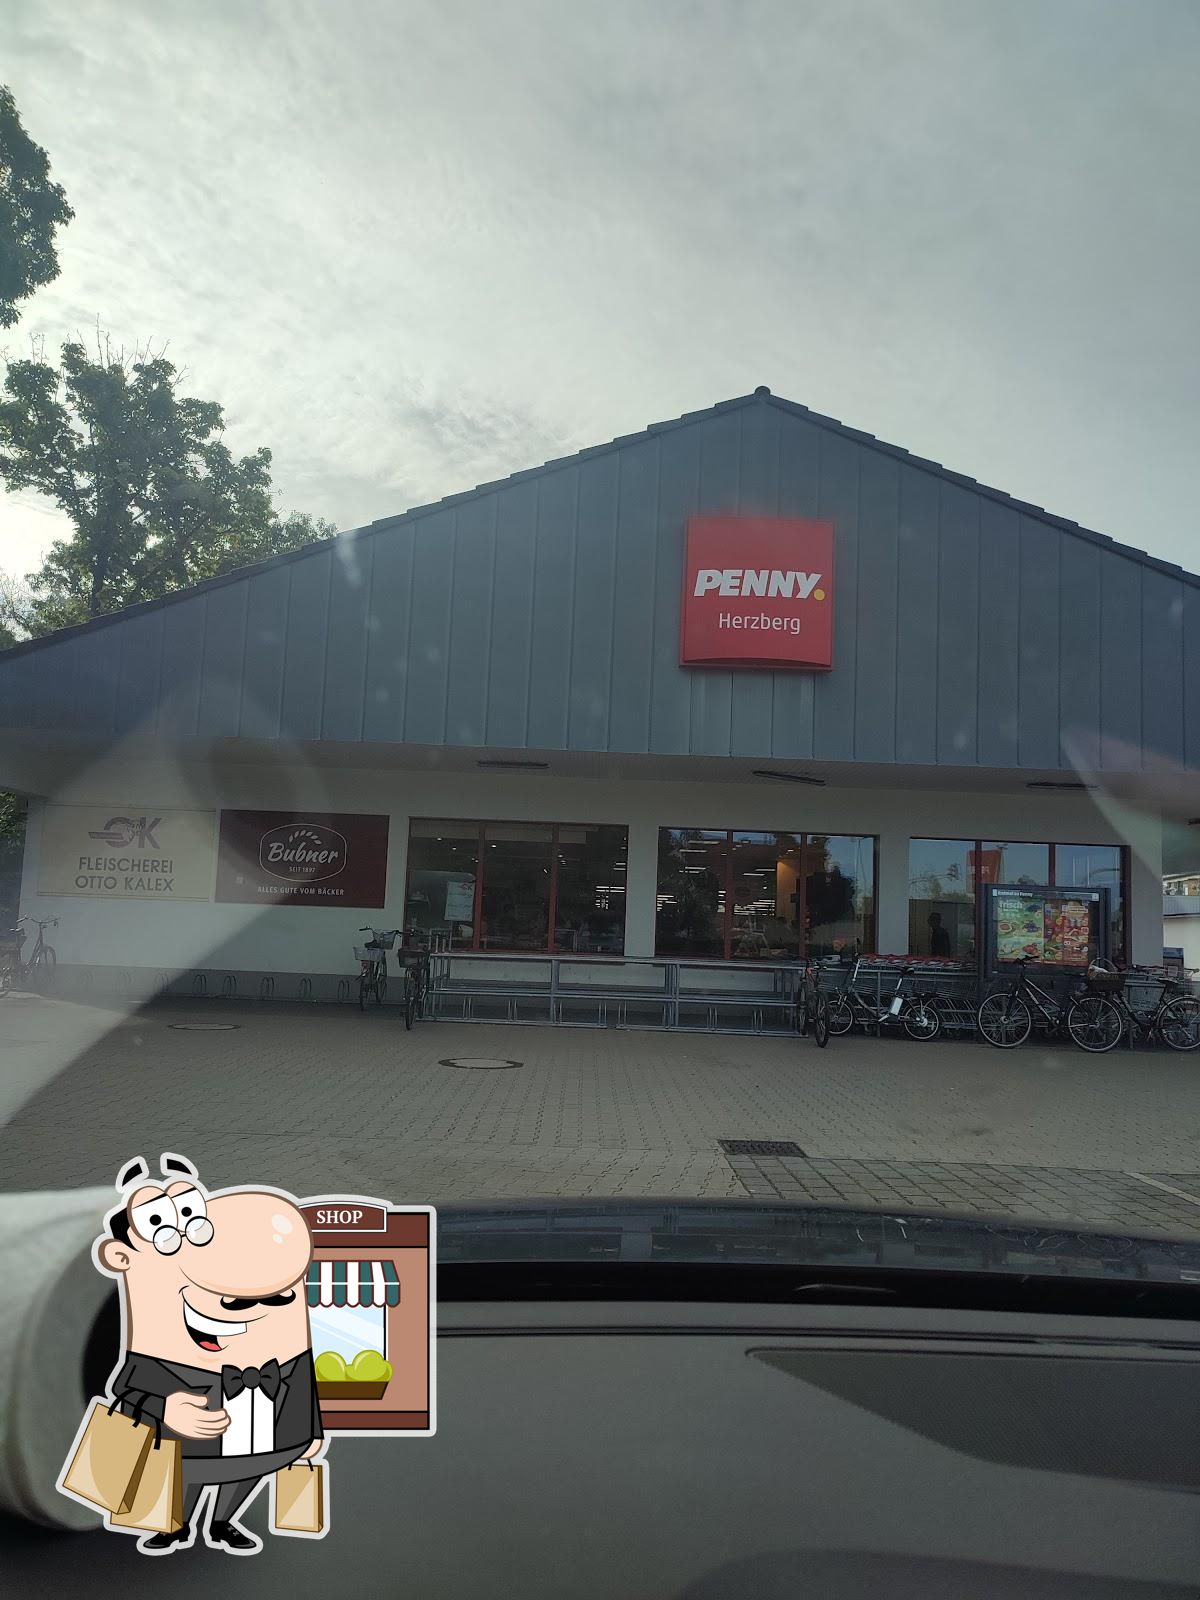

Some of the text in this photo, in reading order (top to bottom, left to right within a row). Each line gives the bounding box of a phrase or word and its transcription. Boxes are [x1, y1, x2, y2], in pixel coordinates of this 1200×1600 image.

[719, 613, 801, 635] Herzberg
[267, 841, 339, 864] Bubner
[79, 856, 173, 873] FLEISCHEREI
[75, 875, 176, 892] OTTO KALEX
[257, 886, 278, 894] ALLES
[299, 887, 316, 895] VOM
